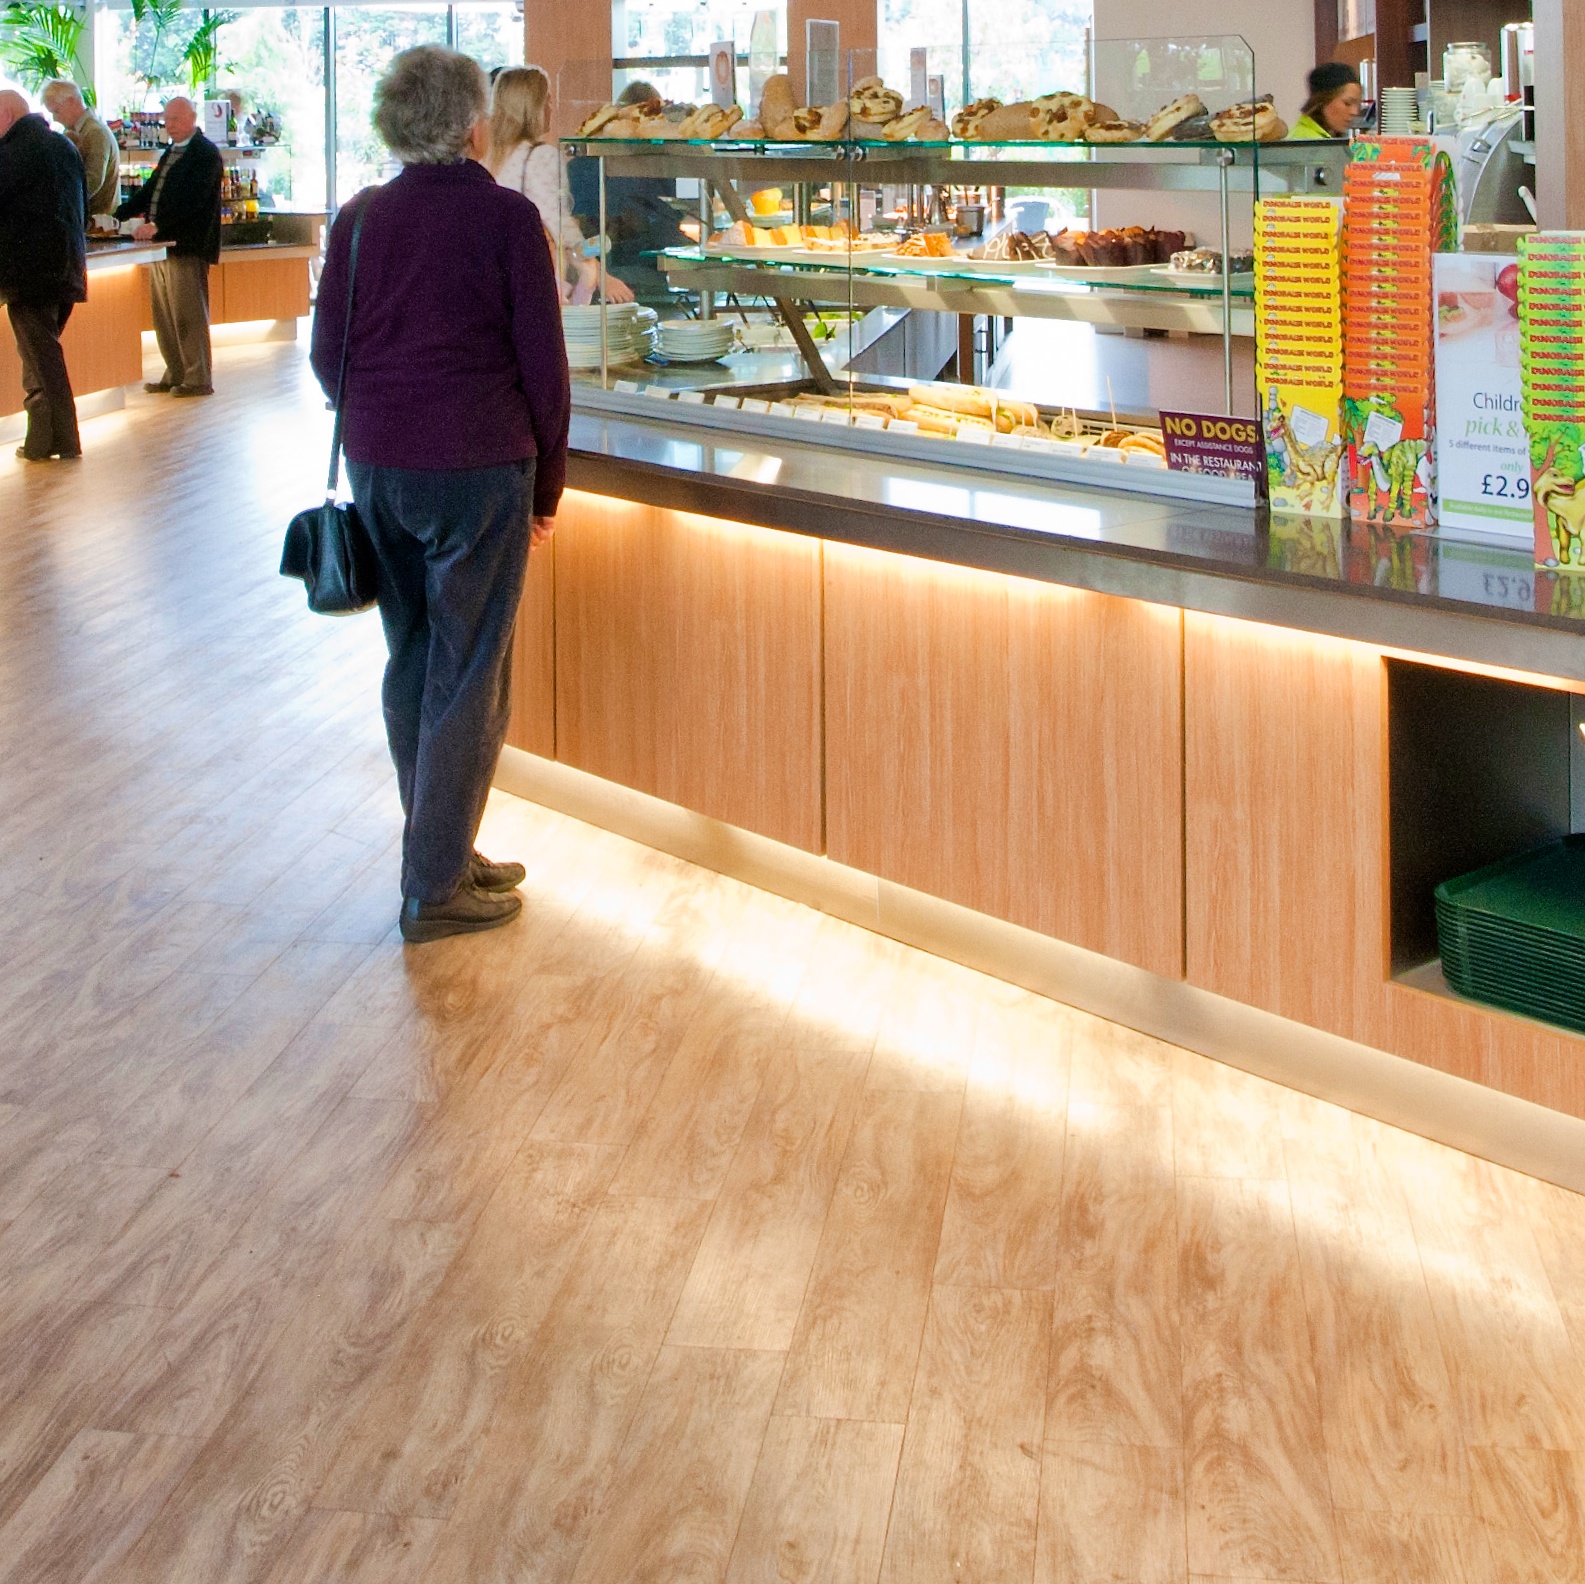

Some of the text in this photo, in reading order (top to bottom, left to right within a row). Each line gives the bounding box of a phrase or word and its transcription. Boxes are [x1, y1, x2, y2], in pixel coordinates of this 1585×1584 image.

[1263, 201, 1301, 209] DINOSAUR
[1262, 231, 1300, 239] DINOSAUR
[1529, 236, 1581, 244] DINOSAUR
[1262, 246, 1300, 254] DINOSAUR
[1528, 254, 1580, 262] DINOSAUR
[1263, 275, 1301, 283] DINOSAUR
[1528, 271, 1580, 279] DINOSAUR
[1529, 287, 1581, 296] DINOSAUR
[1264, 304, 1332, 314] DINOSAUR WORLD
[1529, 303, 1581, 311] DINOSAUR
[1264, 319, 1303, 327] DINOSAUR
[1530, 319, 1582, 327] DINOSAUR
[1265, 333, 1303, 341] DINOSAUR
[1530, 335, 1582, 344] DINOSAUR
[1265, 348, 1333, 358] DINOSAUR WORLD
[1531, 351, 1583, 360] DINOSAUR
[1264, 363, 1332, 373] DINOSAUR WORLD
[1531, 367, 1584, 376] DINOSAUR
[1265, 377, 1333, 388] DINOSAUR WORLD
[1532, 383, 1584, 392] DINOSAUR
[1473, 392, 1520, 412] Childr
[1532, 398, 1585, 408] DINOSAUR
[1532, 413, 1585, 423] DINOSAUR
[1165, 417, 1257, 443] NO DOGS
[1465, 417, 1519, 437] pick &
[1197, 441, 1233, 452] ASSISTANCE
[1234, 445, 1254, 454] DOGS
[1449, 439, 1527, 456] 5 different items of
[1170, 453, 1262, 472] IN THE RESTAURANT
[1500, 461, 1523, 474] only
[1481, 474, 1530, 499] £2.9
